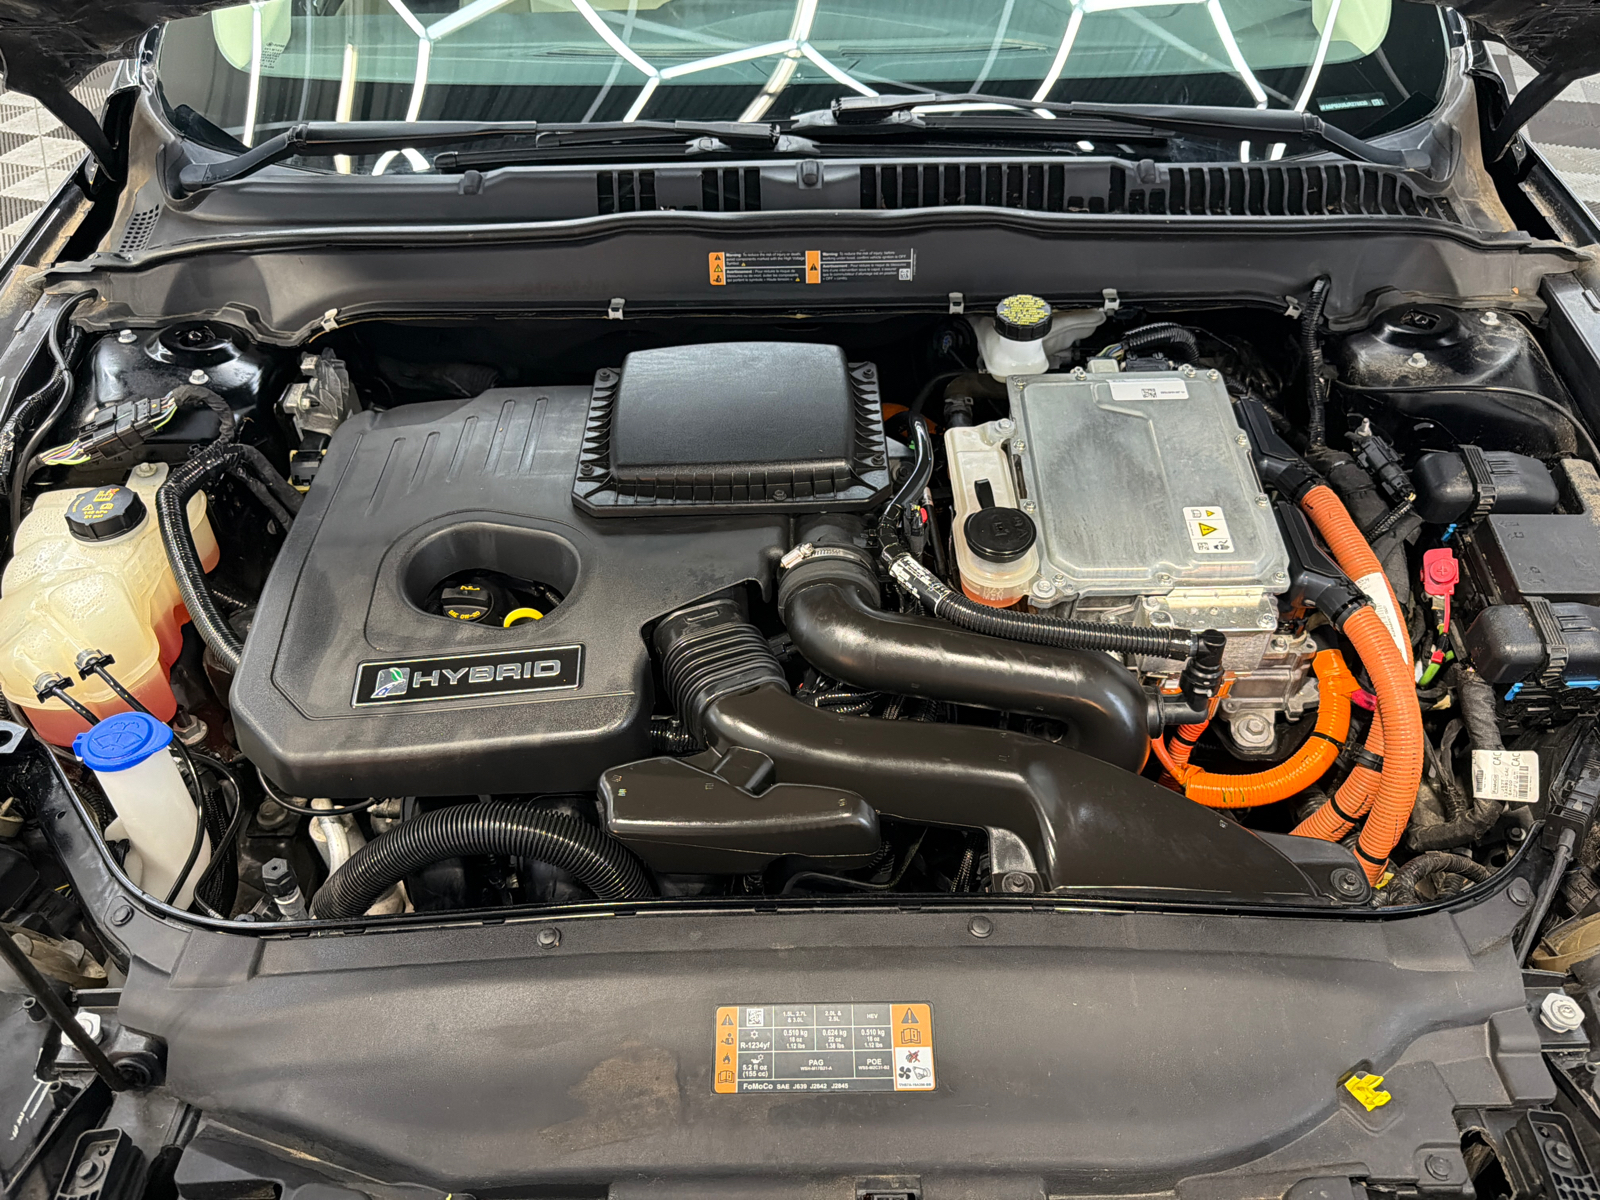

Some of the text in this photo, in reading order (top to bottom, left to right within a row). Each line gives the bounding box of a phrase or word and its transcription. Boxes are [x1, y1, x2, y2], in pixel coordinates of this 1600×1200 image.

[412, 659, 562, 688] HYBRID
[1492, 752, 1503, 766] CAC
[1511, 752, 1521, 767] CAC
[800, 1029, 808, 1037] kg
[839, 1029, 847, 1037] kg
[877, 1029, 885, 1037] kg
[740, 1041, 771, 1050] R-1234yf
[743, 1082, 774, 1090] FoMoCo
